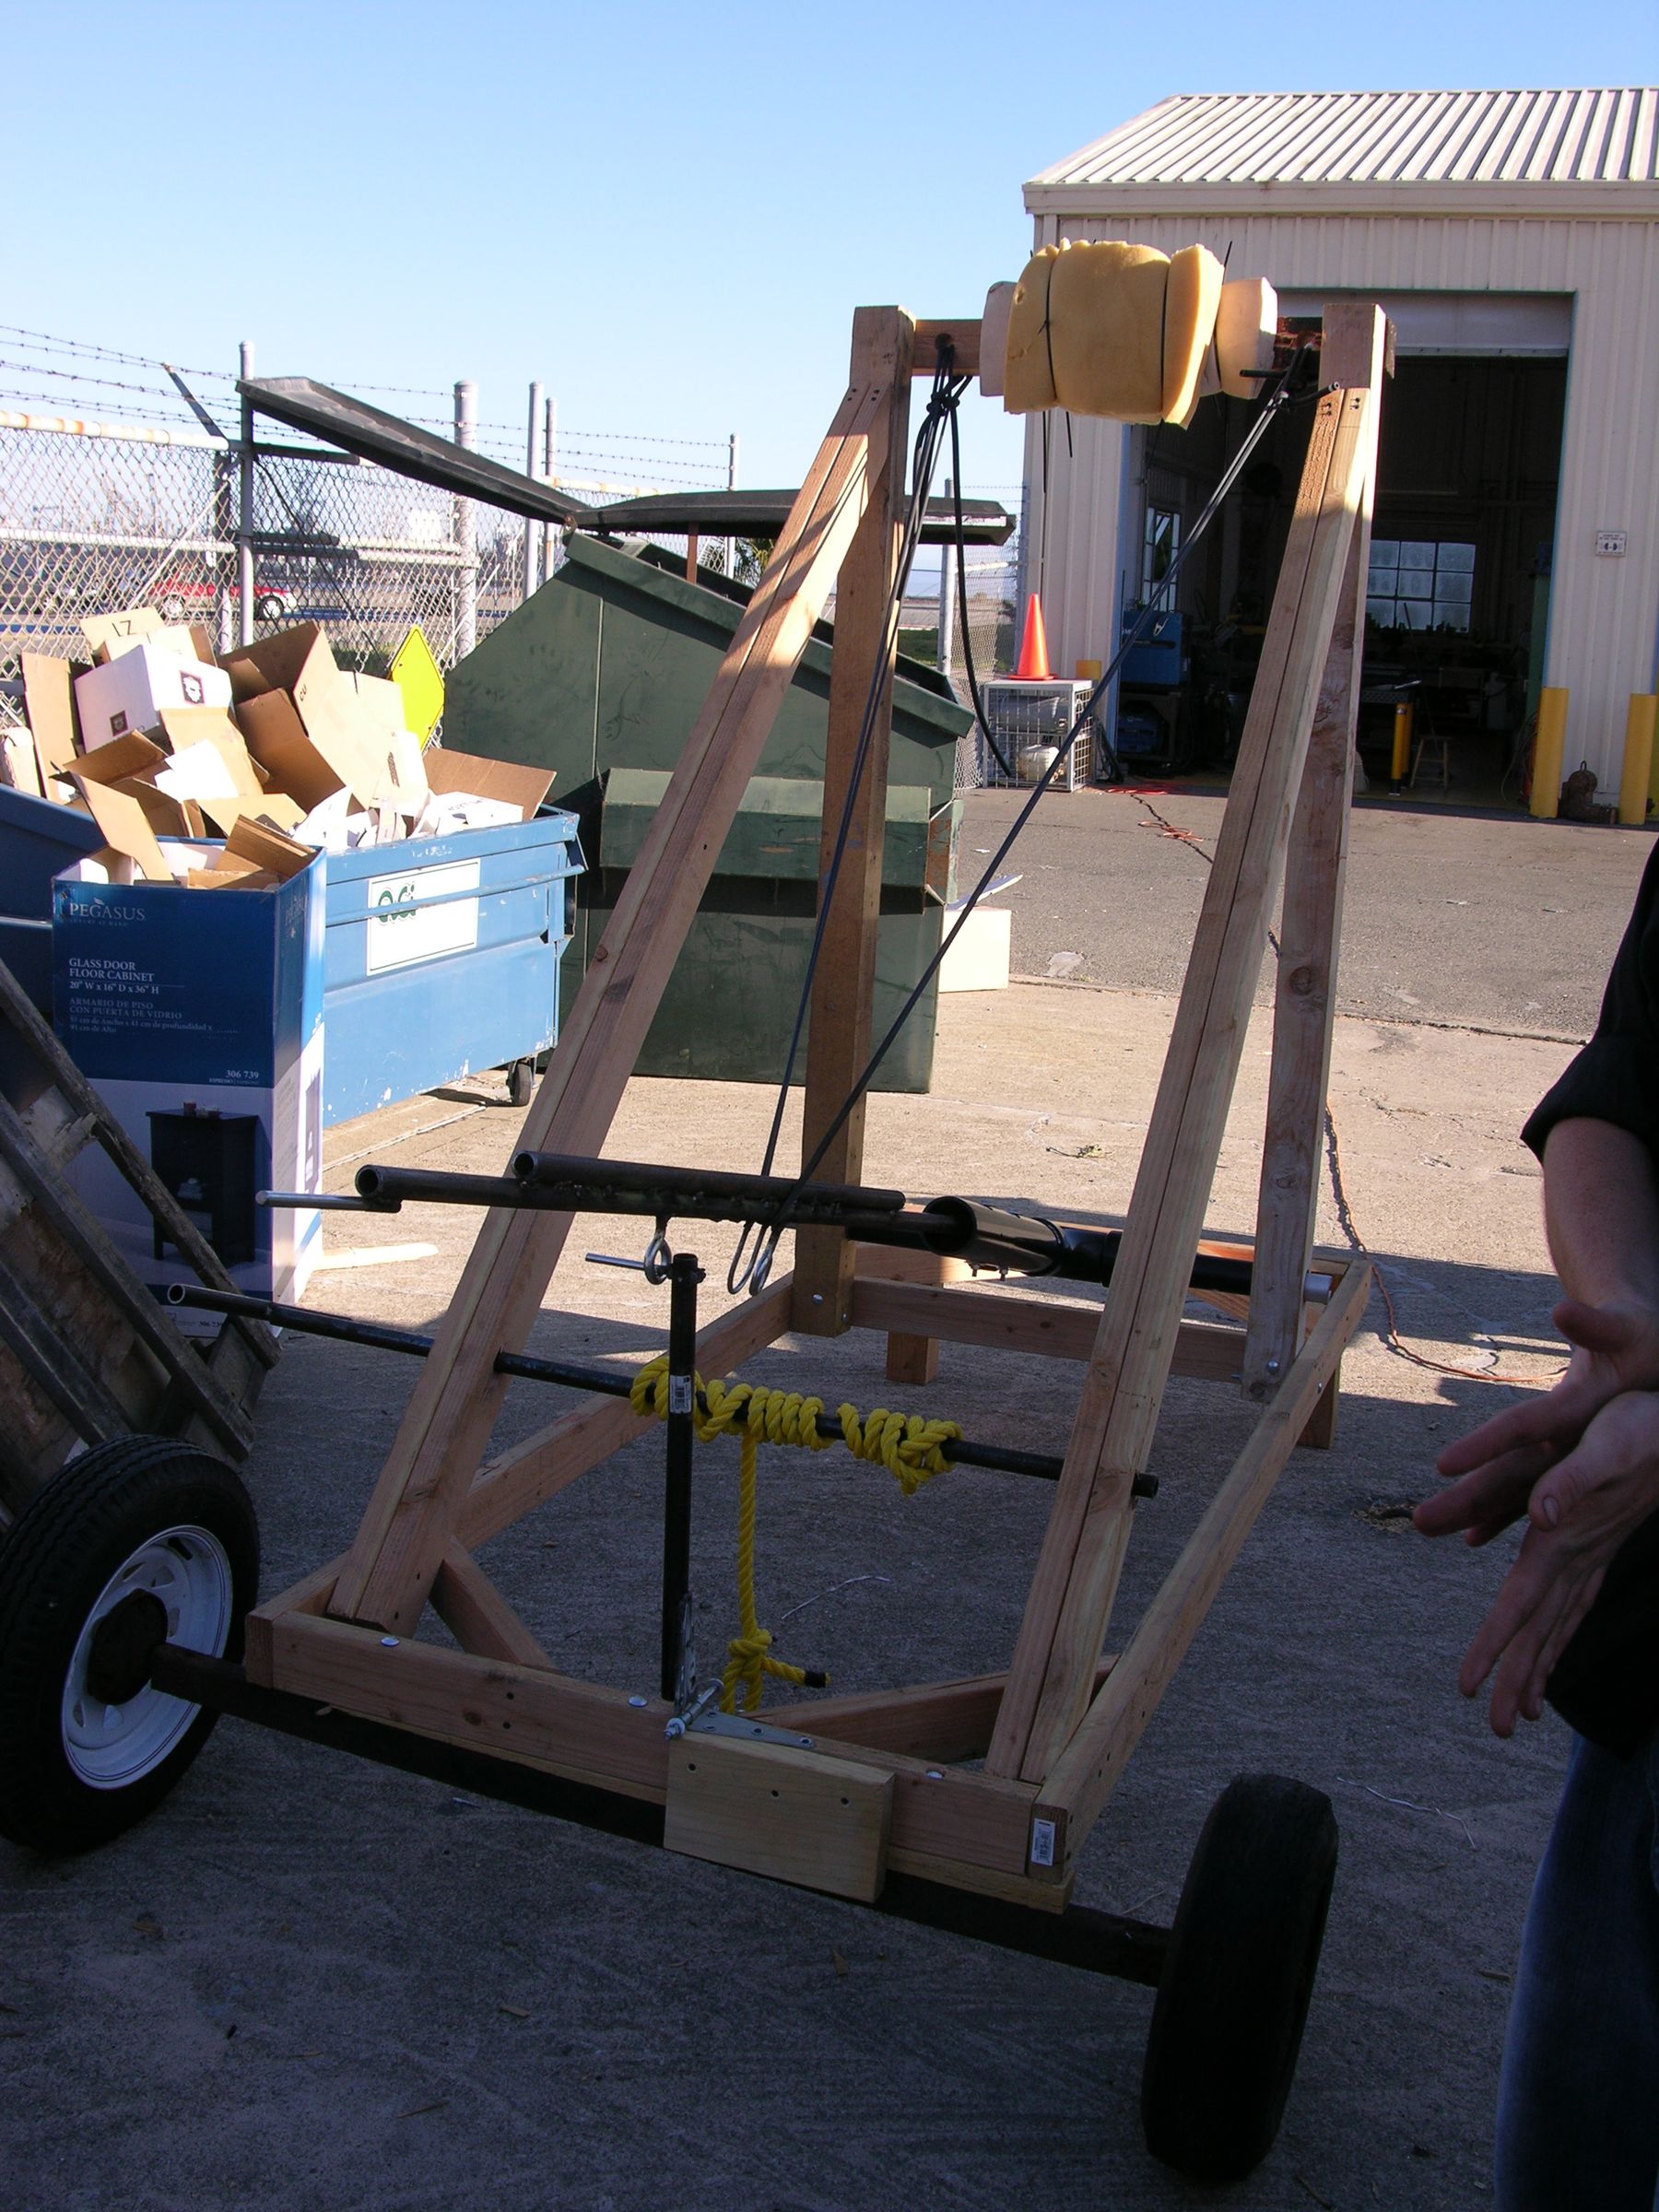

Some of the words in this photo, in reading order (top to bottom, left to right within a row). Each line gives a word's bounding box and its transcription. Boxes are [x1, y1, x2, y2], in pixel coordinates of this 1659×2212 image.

[69, 902, 146, 922] PEGASUS
[69, 958, 101, 969] GLASS
[103, 960, 136, 971] DOOR
[69, 968, 105, 979] FLOOR
[107, 971, 155, 982] CABINET
[118, 983, 126, 993] D
[151, 986, 159, 994] H
[70, 997, 114, 1007] ARMARIO
[116, 1000, 130, 1008] DE
[131, 1001, 154, 1010] PISO
[69, 1006, 90, 1014] CON
[93, 1007, 130, 1017] PUERTA
[132, 1009, 147, 1018] DE
[147, 1010, 182, 1019] VIDRIO
[225, 1070, 241, 1078] 306
[243, 1070, 259, 1079] 739
